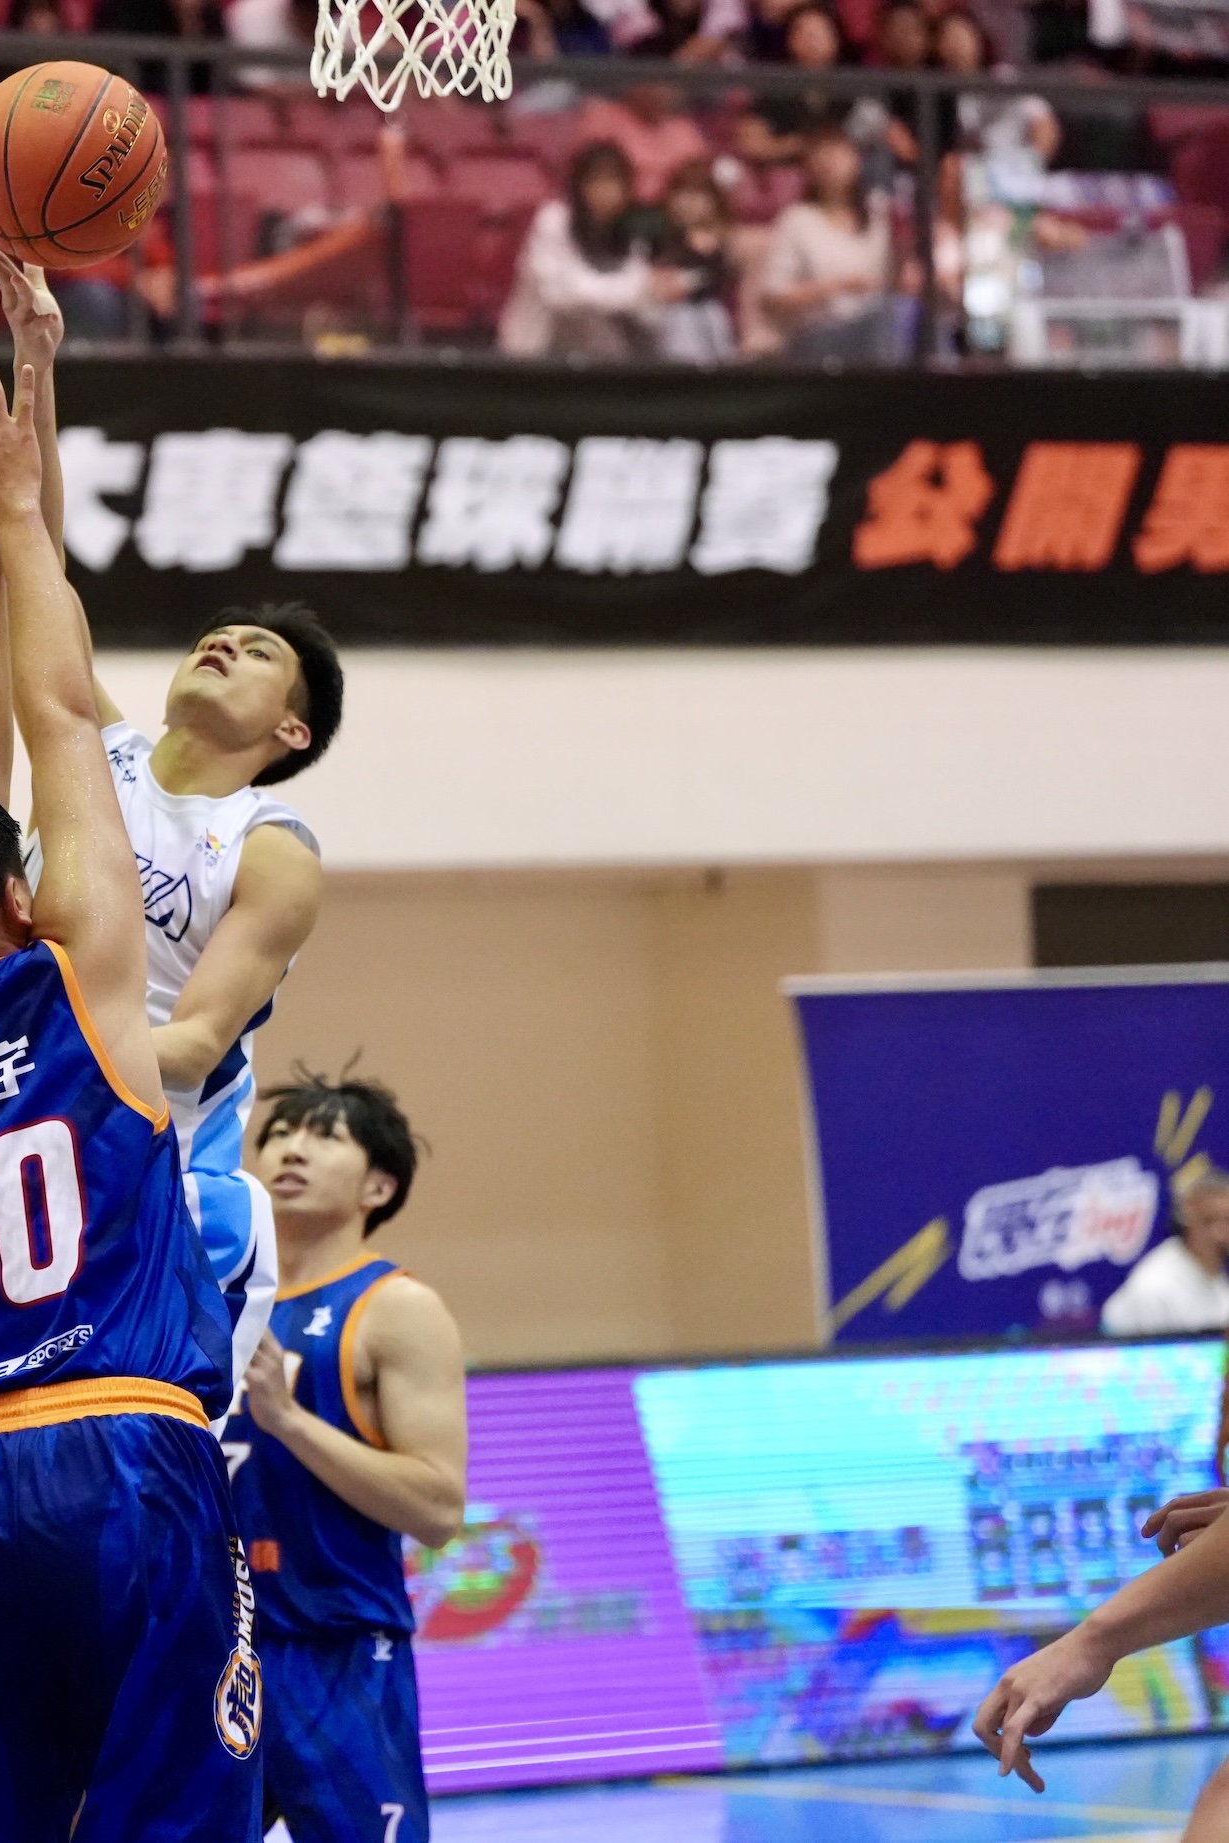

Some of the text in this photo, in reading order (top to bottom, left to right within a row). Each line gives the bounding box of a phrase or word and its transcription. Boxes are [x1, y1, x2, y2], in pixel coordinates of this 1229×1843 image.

[78, 86, 148, 201] SPALDIN
[28, 1329, 90, 1367] SPORTS
[380, 1802, 405, 1843] 7
